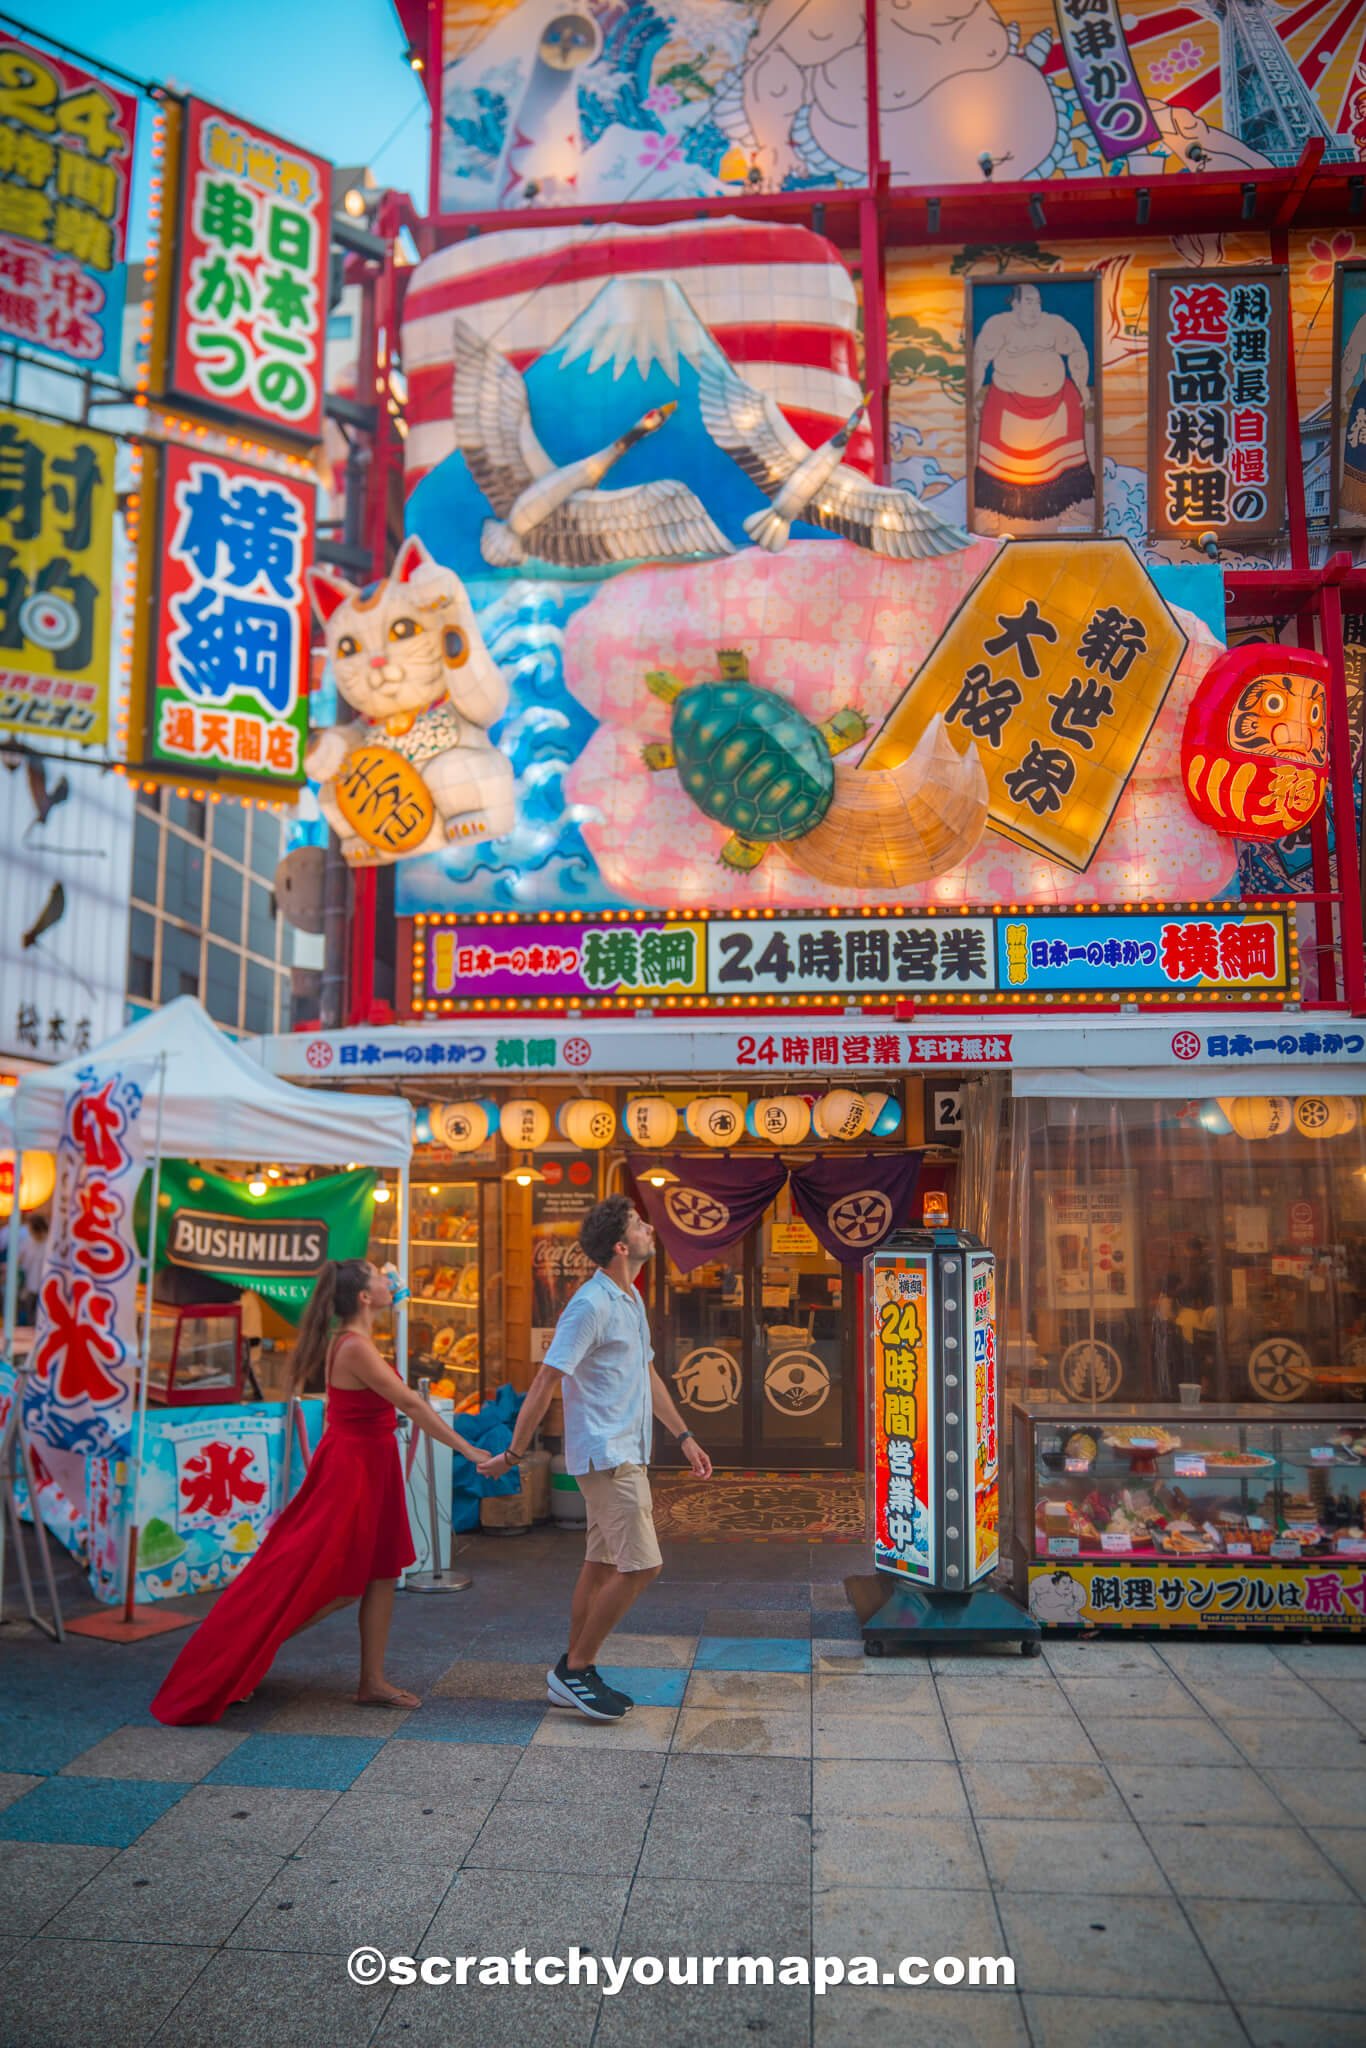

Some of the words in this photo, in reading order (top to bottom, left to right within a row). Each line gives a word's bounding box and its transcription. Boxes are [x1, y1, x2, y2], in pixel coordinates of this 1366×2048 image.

[0, 51, 124, 158] 24
[197, 181, 253, 387] 串かつ
[258, 205, 311, 410] 日本一の
[1169, 286, 1229, 523] 逸品料理
[1231, 287, 1269, 520] 料理長自慢の
[0, 424, 103, 672] 射的
[177, 471, 297, 711] 横綱
[944, 600, 1058, 748] 大阪
[1004, 607, 1148, 816] 新世界
[164, 706, 294, 769] 通天閣店
[458, 948, 578, 974] 日本一の串かつ
[583, 930, 695, 986] 横綱
[718, 928, 987, 983] 24時間営業
[1031, 939, 1157, 968] 日本一の串かつ
[1162, 922, 1277, 981] 横綱
[339, 1043, 487, 1065] 日本一の串かつ
[736, 1034, 901, 1065] 24時間営業
[915, 1037, 1007, 1061] 年中無休
[1207, 1033, 1365, 1057] 日本一の串かつ
[35, 1078, 127, 1400] かき氷
[173, 1218, 320, 1262] BUSHMILLS
[232, 1283, 309, 1299] HISKEY
[180, 1441, 267, 1517] 氷
[882, 1304, 920, 1550] 24時間営業中
